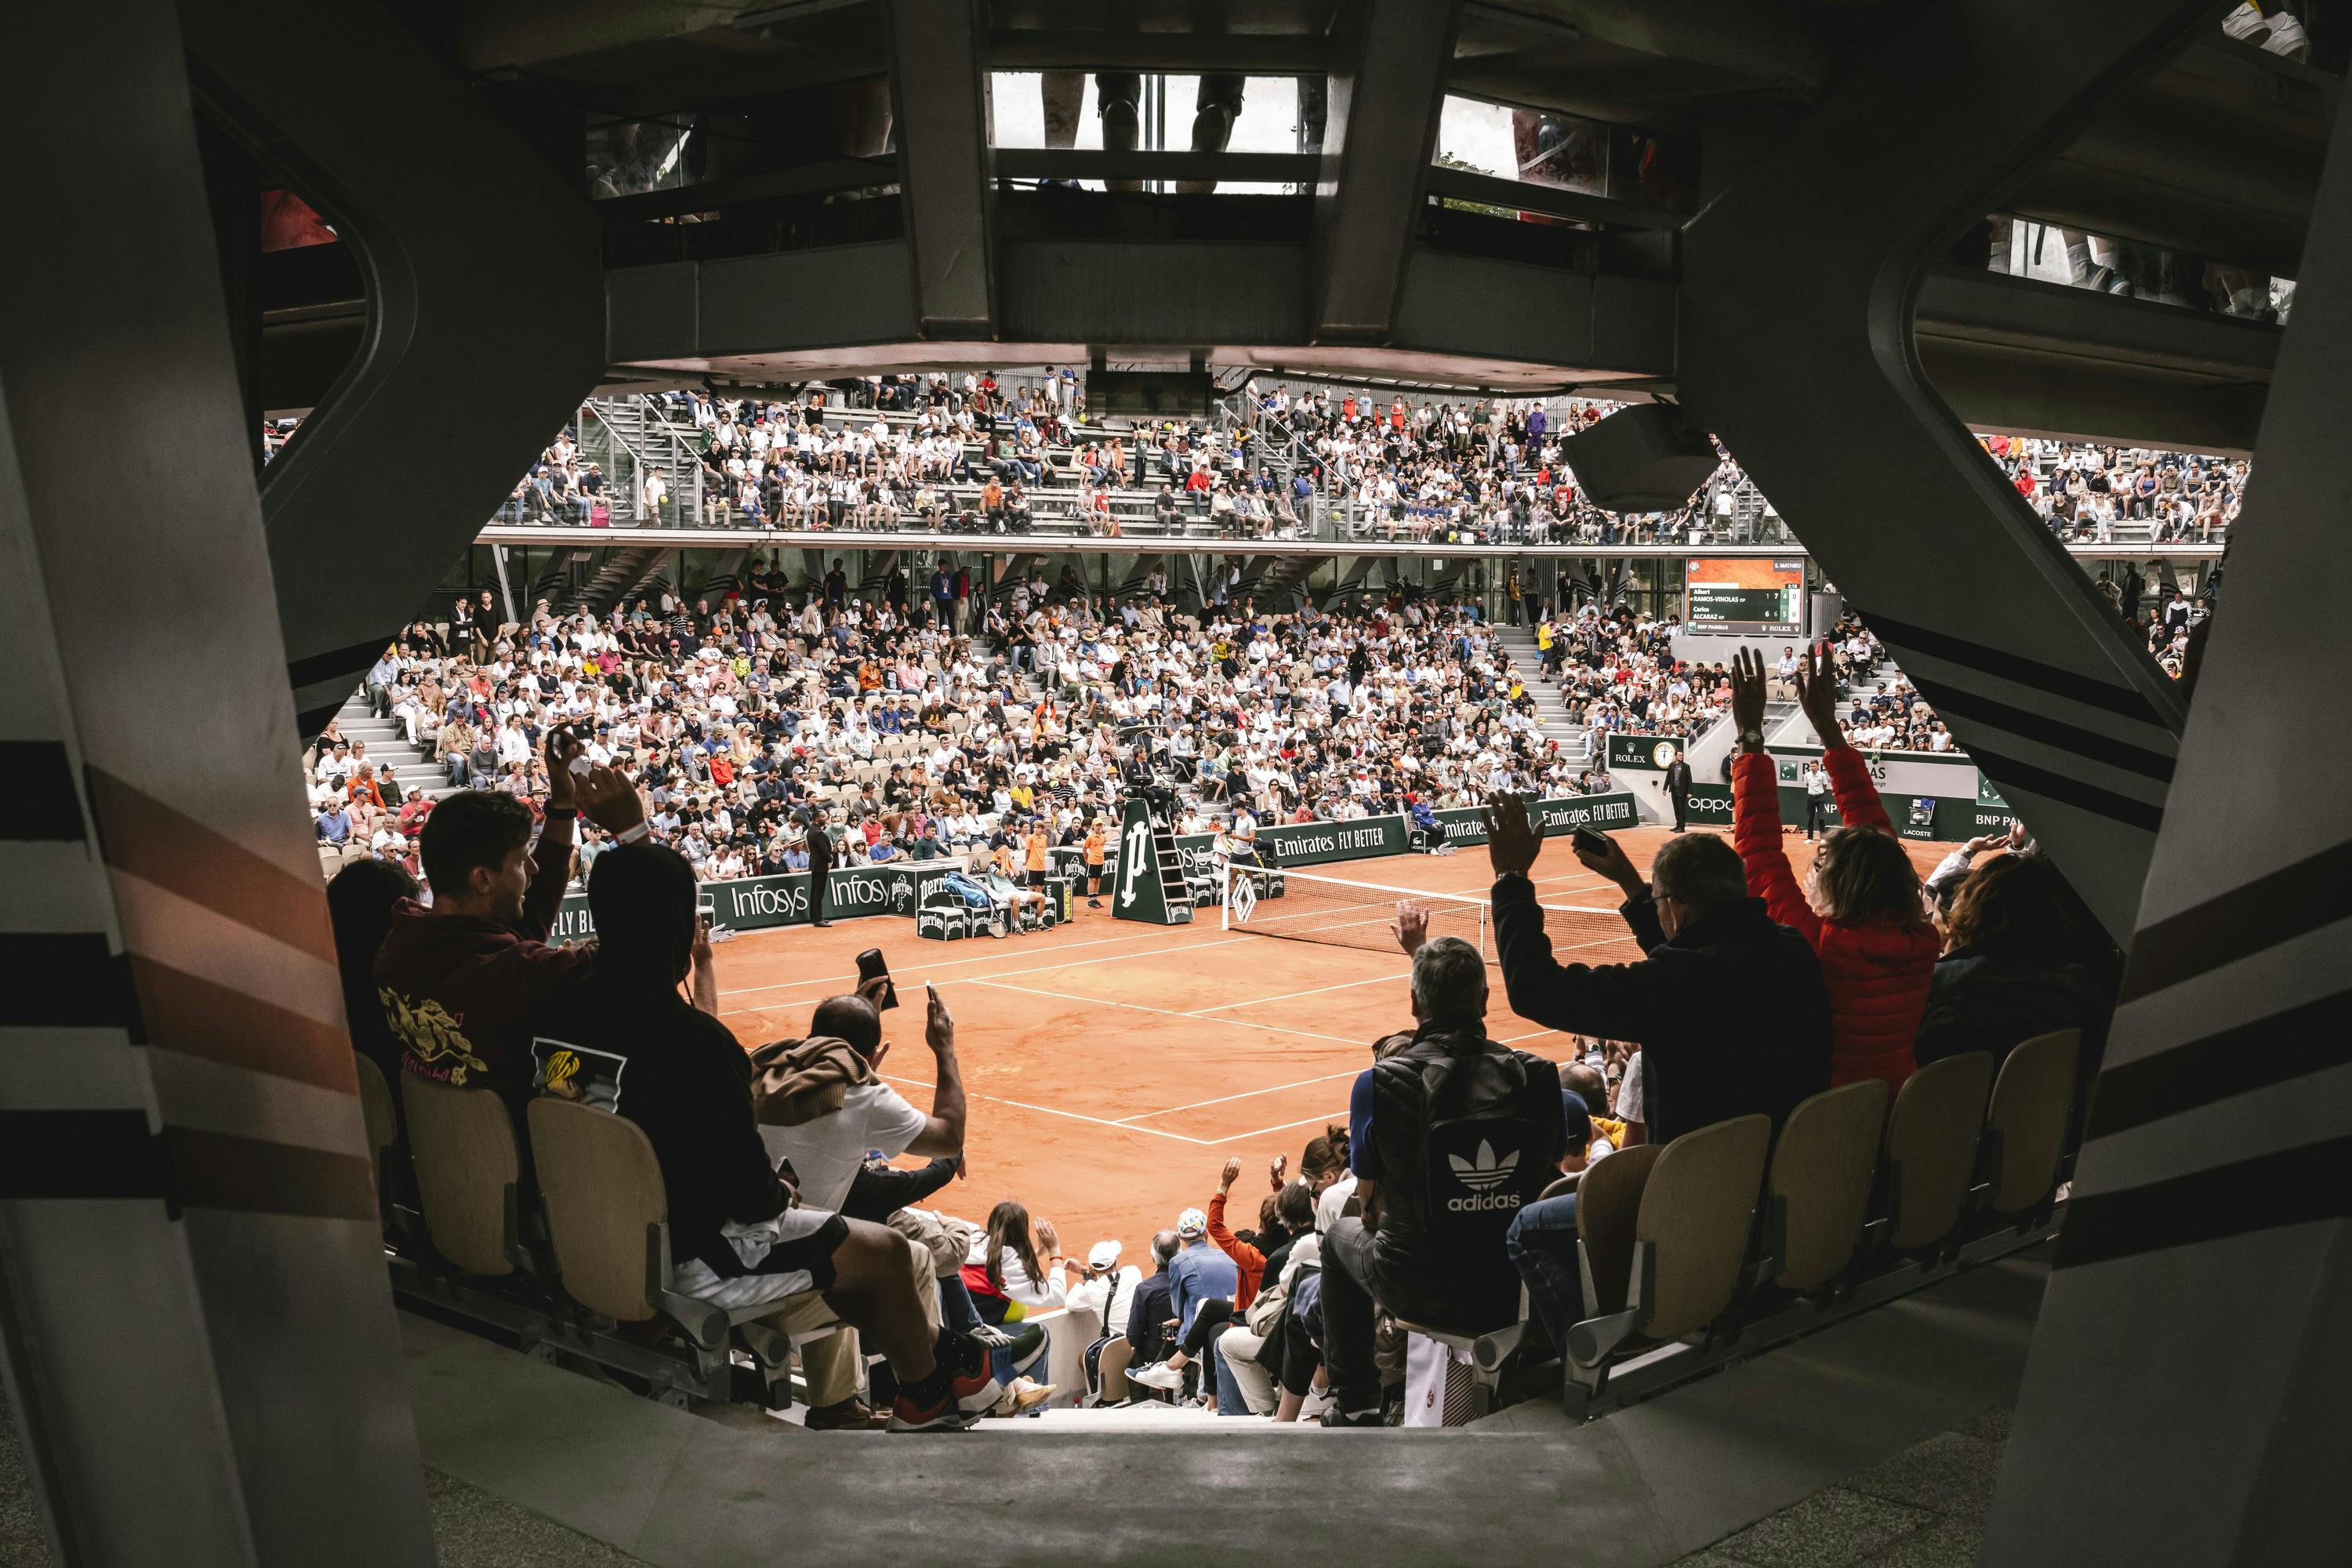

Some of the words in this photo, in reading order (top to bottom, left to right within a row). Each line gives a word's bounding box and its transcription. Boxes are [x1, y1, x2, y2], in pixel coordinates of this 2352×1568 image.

[1615, 753, 1646, 764] ROLEX
[1541, 808, 1590, 826] Emirates
[1593, 805, 1606, 822] FLY
[1606, 802, 1630, 820] BETTER
[1976, 815, 2001, 826] BNP
[1443, 818, 1488, 838] mirates
[1903, 829, 1932, 837] LACOSTE
[1274, 835, 1334, 857] Emirates
[1338, 830, 1355, 850] FLY
[1354, 827, 1385, 848] BETTER
[731, 884, 808, 917] Infosys
[829, 874, 889, 907] Infosy
[891, 880, 913, 902] perrier
[919, 913, 944, 935] perrier
[947, 918, 964, 935] perrier
[975, 915, 992, 933] perrie
[1447, 1191, 1520, 1212] adidas
